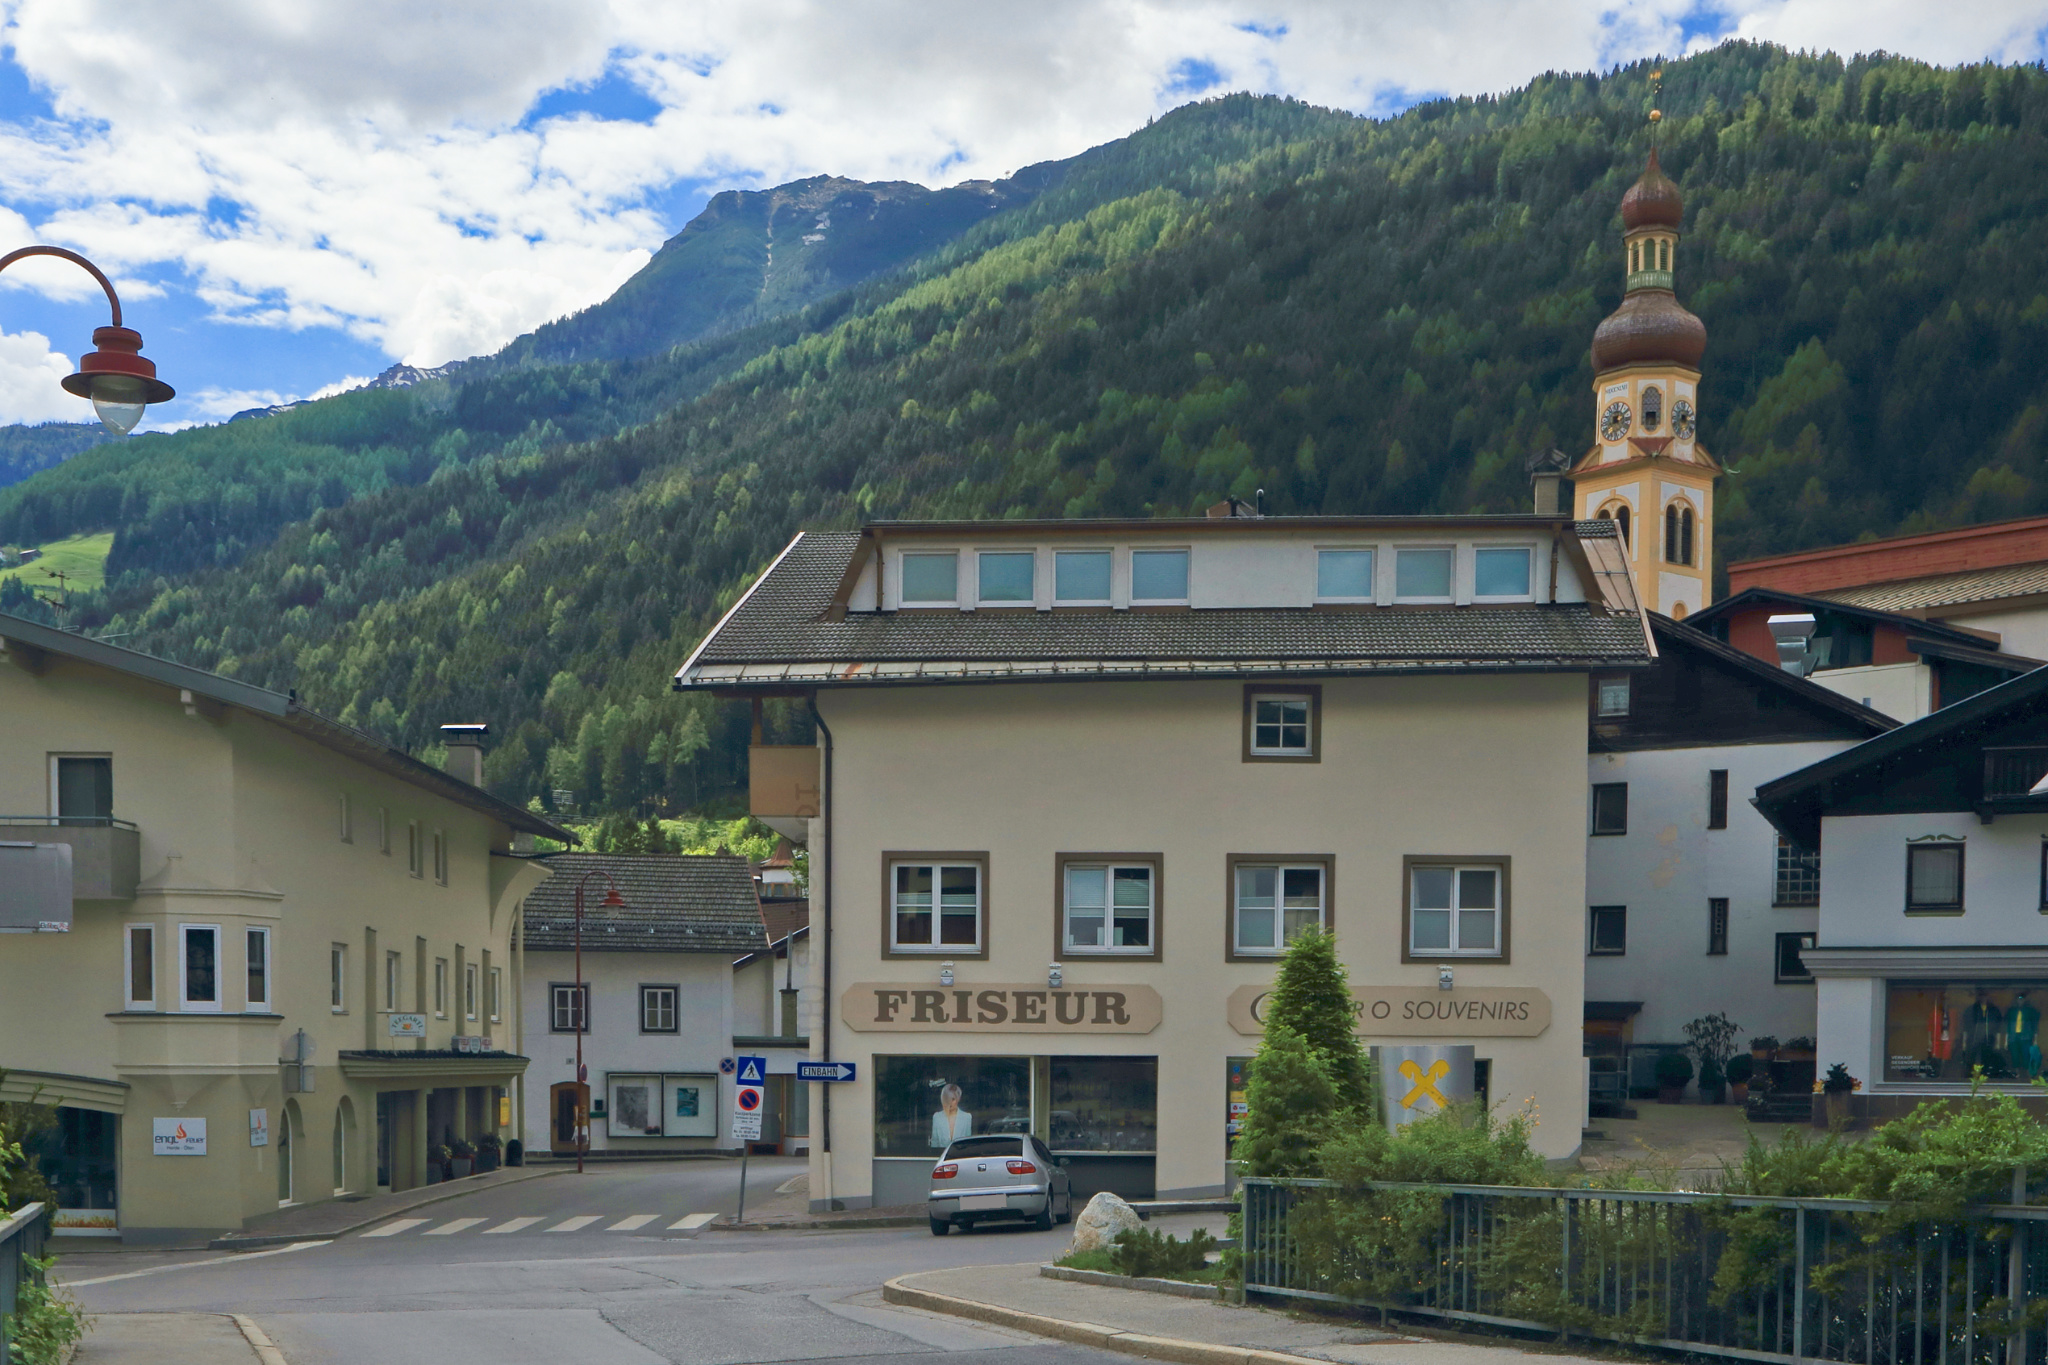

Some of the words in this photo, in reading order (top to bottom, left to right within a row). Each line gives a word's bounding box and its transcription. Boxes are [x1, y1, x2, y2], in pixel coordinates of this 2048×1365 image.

[873, 989, 1131, 1025] FRISEUR
[1402, 1001, 1530, 1021] SOUVENIRS
[803, 1067, 838, 1076] EINBAHN
